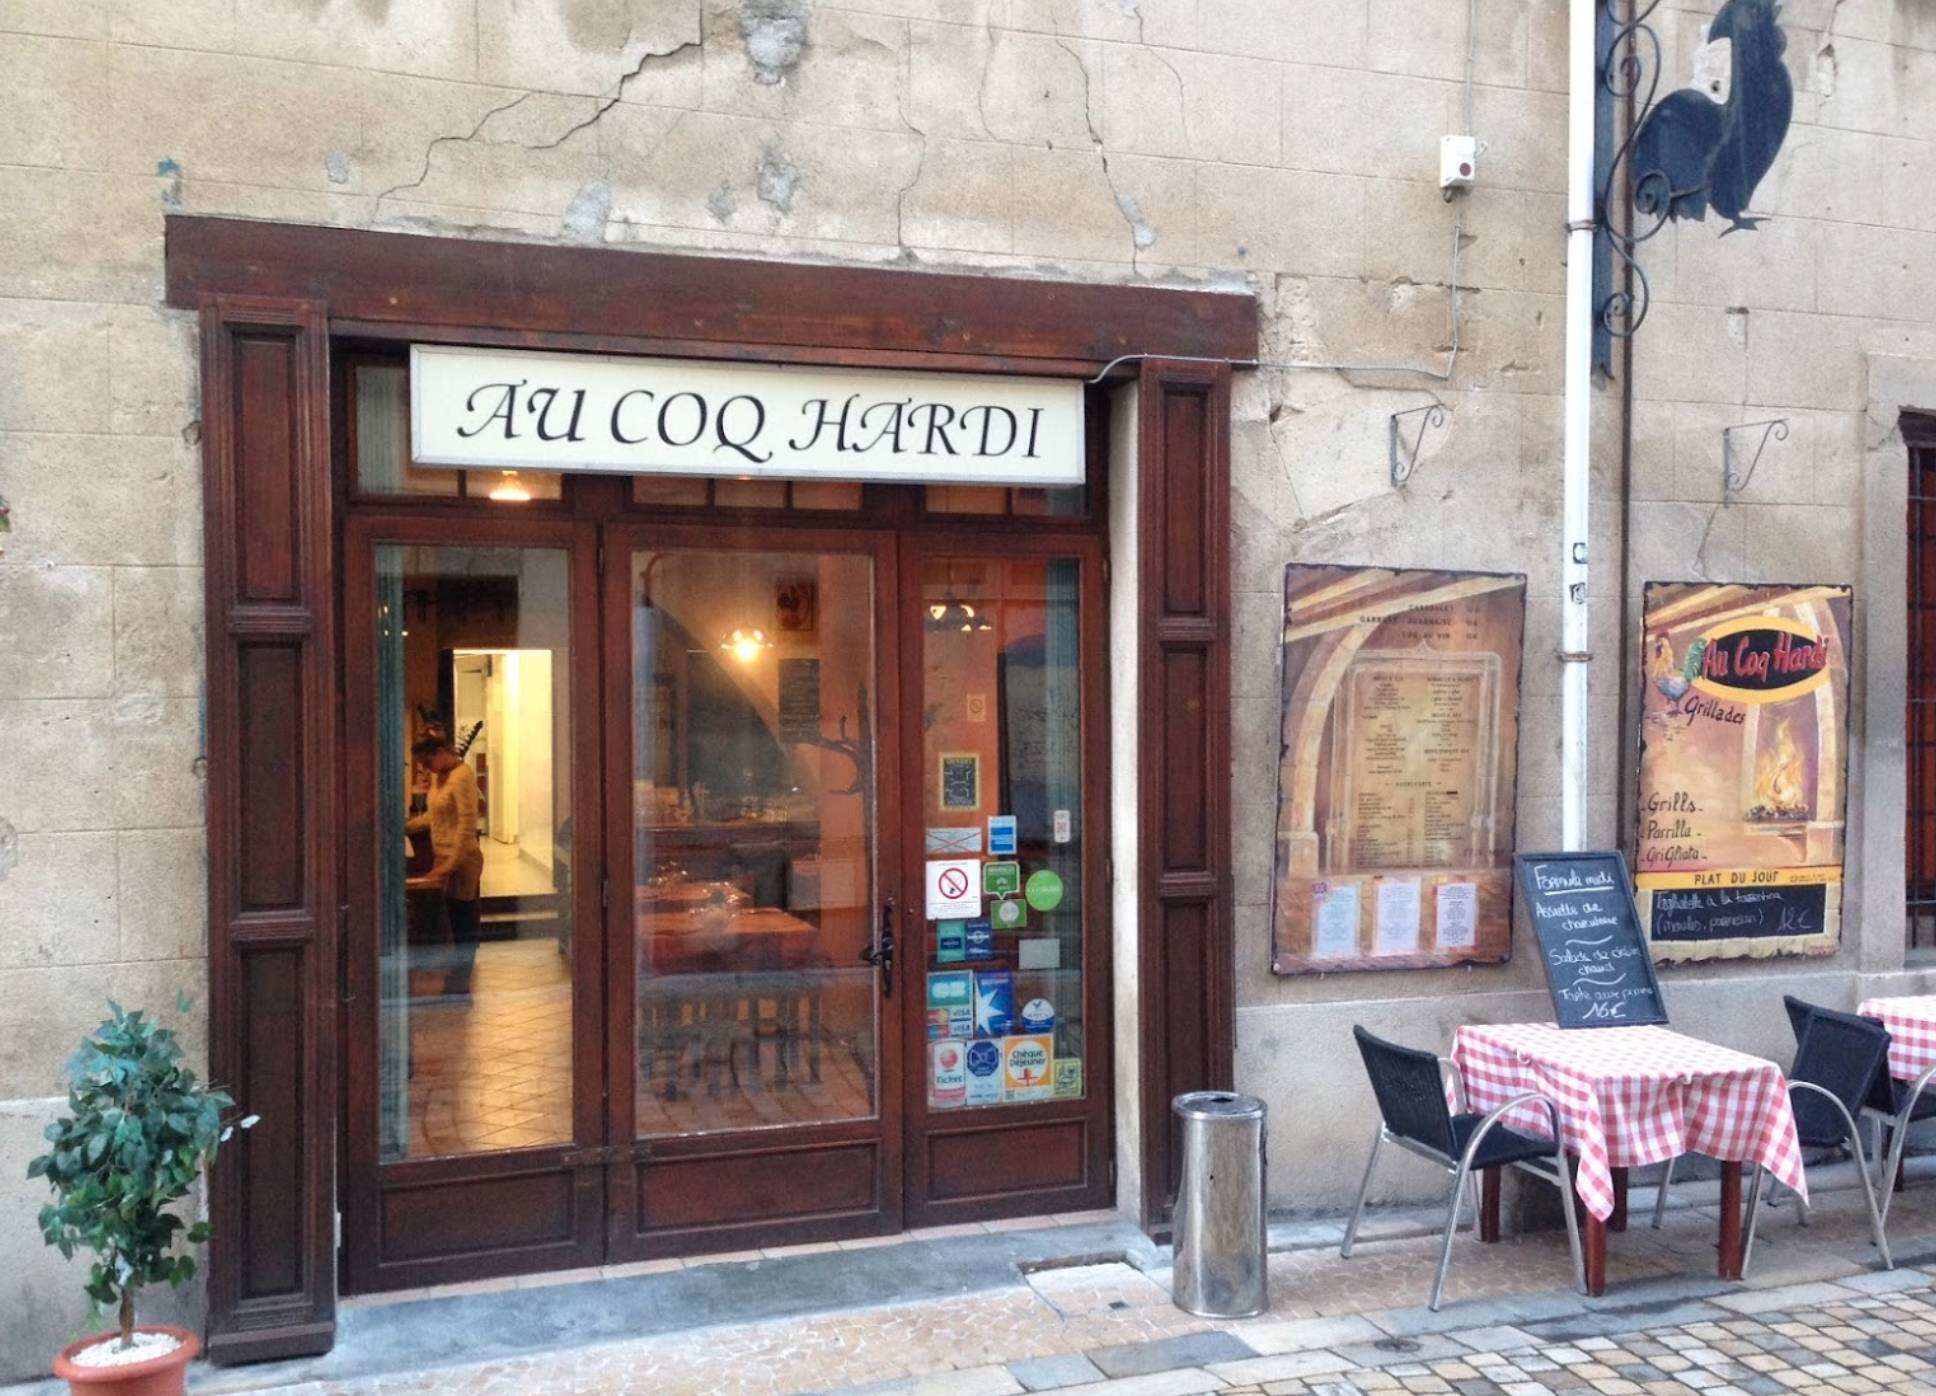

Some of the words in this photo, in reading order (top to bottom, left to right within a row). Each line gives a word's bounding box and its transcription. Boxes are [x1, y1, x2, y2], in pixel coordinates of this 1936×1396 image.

[457, 379, 586, 443] AU
[610, 389, 773, 463] COQ
[789, 393, 1046, 459] HARDI
[1703, 638, 1728, 680] Au
[1734, 635, 1769, 682] Coq
[1774, 631, 1829, 673] Hardi
[1685, 695, 1746, 726] Grillades
[1534, 864, 1583, 890] Formule
[1694, 873, 1721, 885] PLAT
[1731, 872, 1746, 884] DU
[1583, 903, 1603, 914] de
